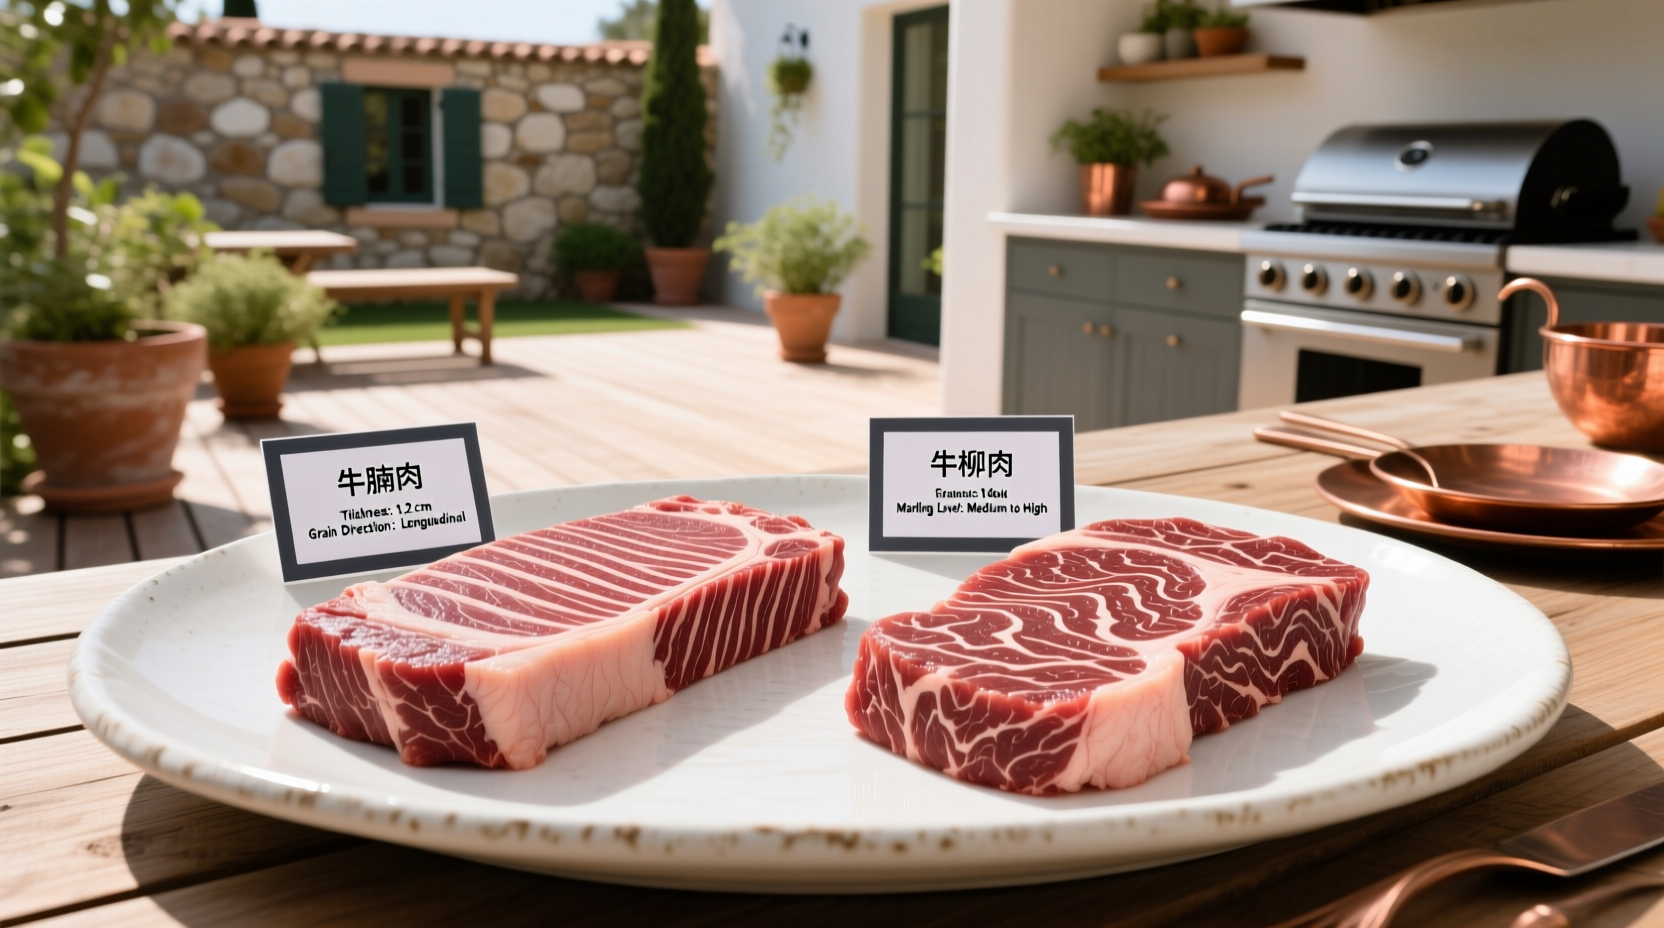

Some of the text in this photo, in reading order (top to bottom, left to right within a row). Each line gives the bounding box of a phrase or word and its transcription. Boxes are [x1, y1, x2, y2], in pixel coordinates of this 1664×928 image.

[930, 449, 1013, 478] 牛柳肉
[1010, 503, 1020, 514] to
[1023, 502, 1048, 516] High
[308, 525, 338, 540] Grain
